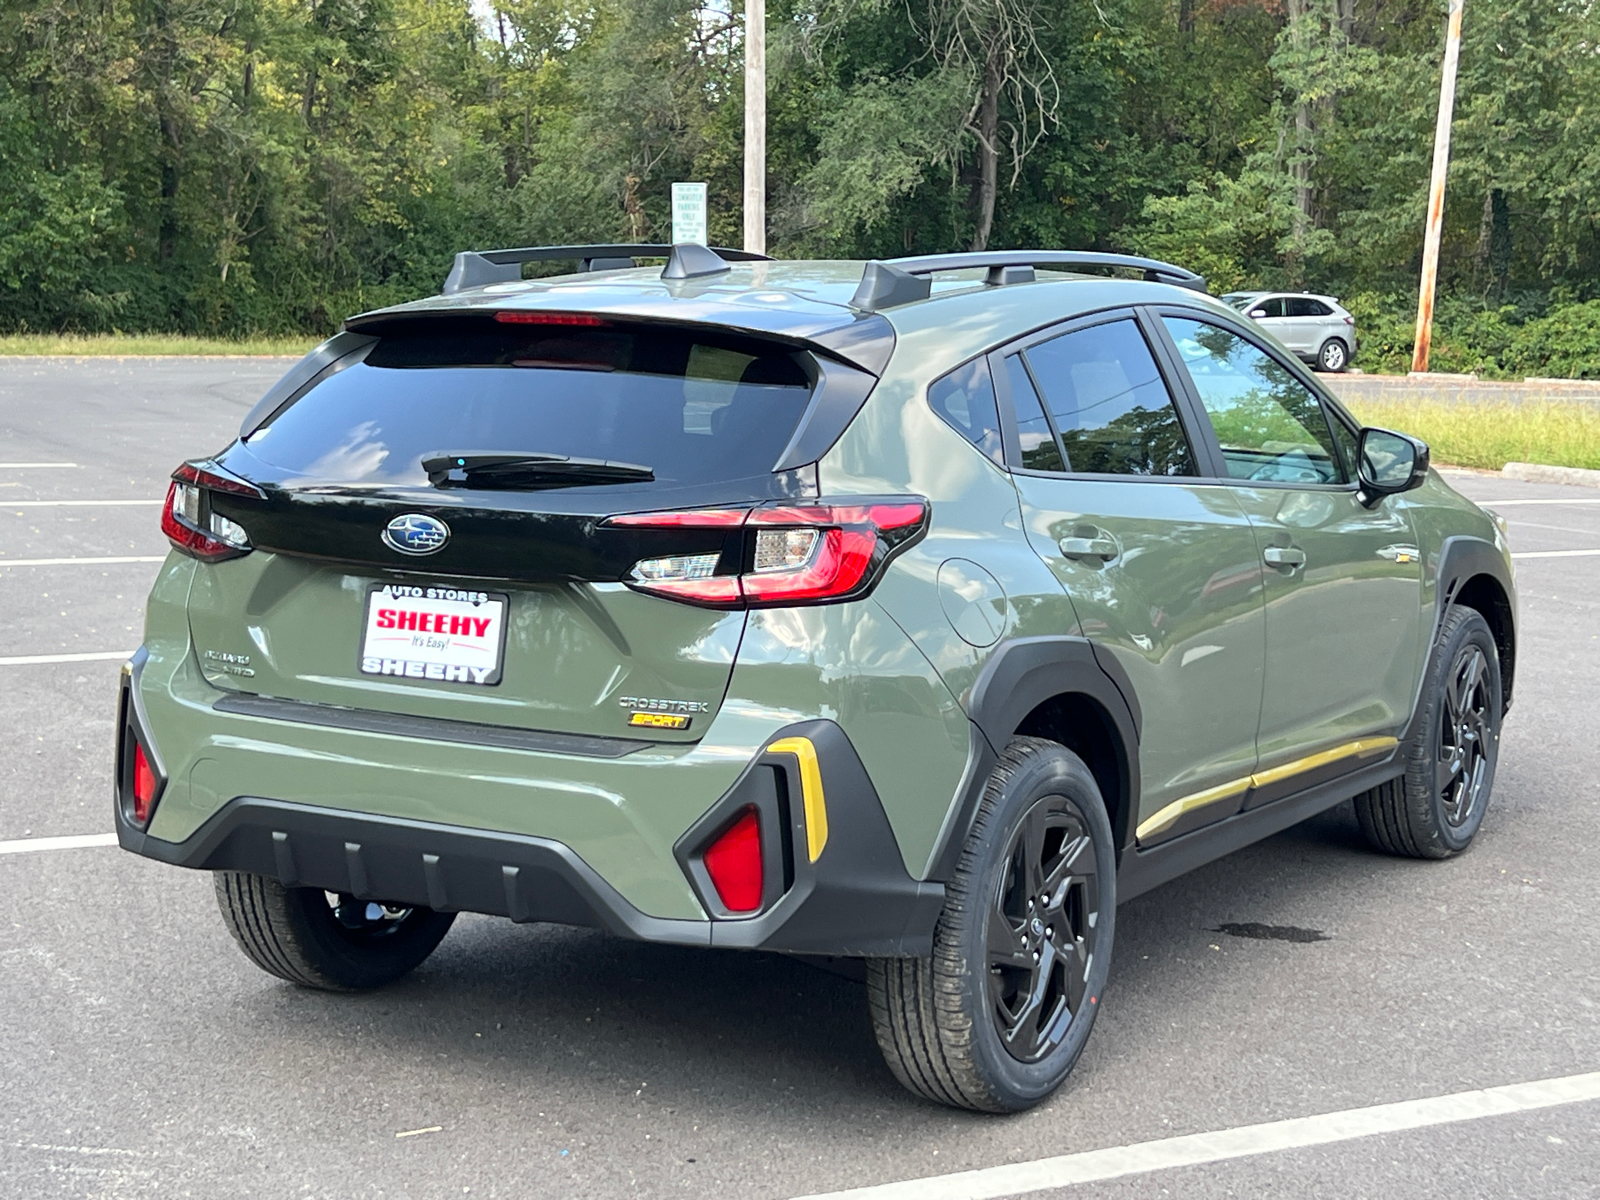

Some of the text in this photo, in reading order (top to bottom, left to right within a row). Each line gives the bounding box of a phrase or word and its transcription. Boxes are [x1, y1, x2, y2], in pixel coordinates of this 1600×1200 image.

[382, 584, 488, 603] AUTO STORES
[376, 608, 492, 638] SHEEHY
[411, 635, 450, 651] It's Easy!
[361, 657, 494, 684] SHEEHY
[618, 696, 709, 713] CROSSTREK
[631, 713, 685, 727] SPORT
